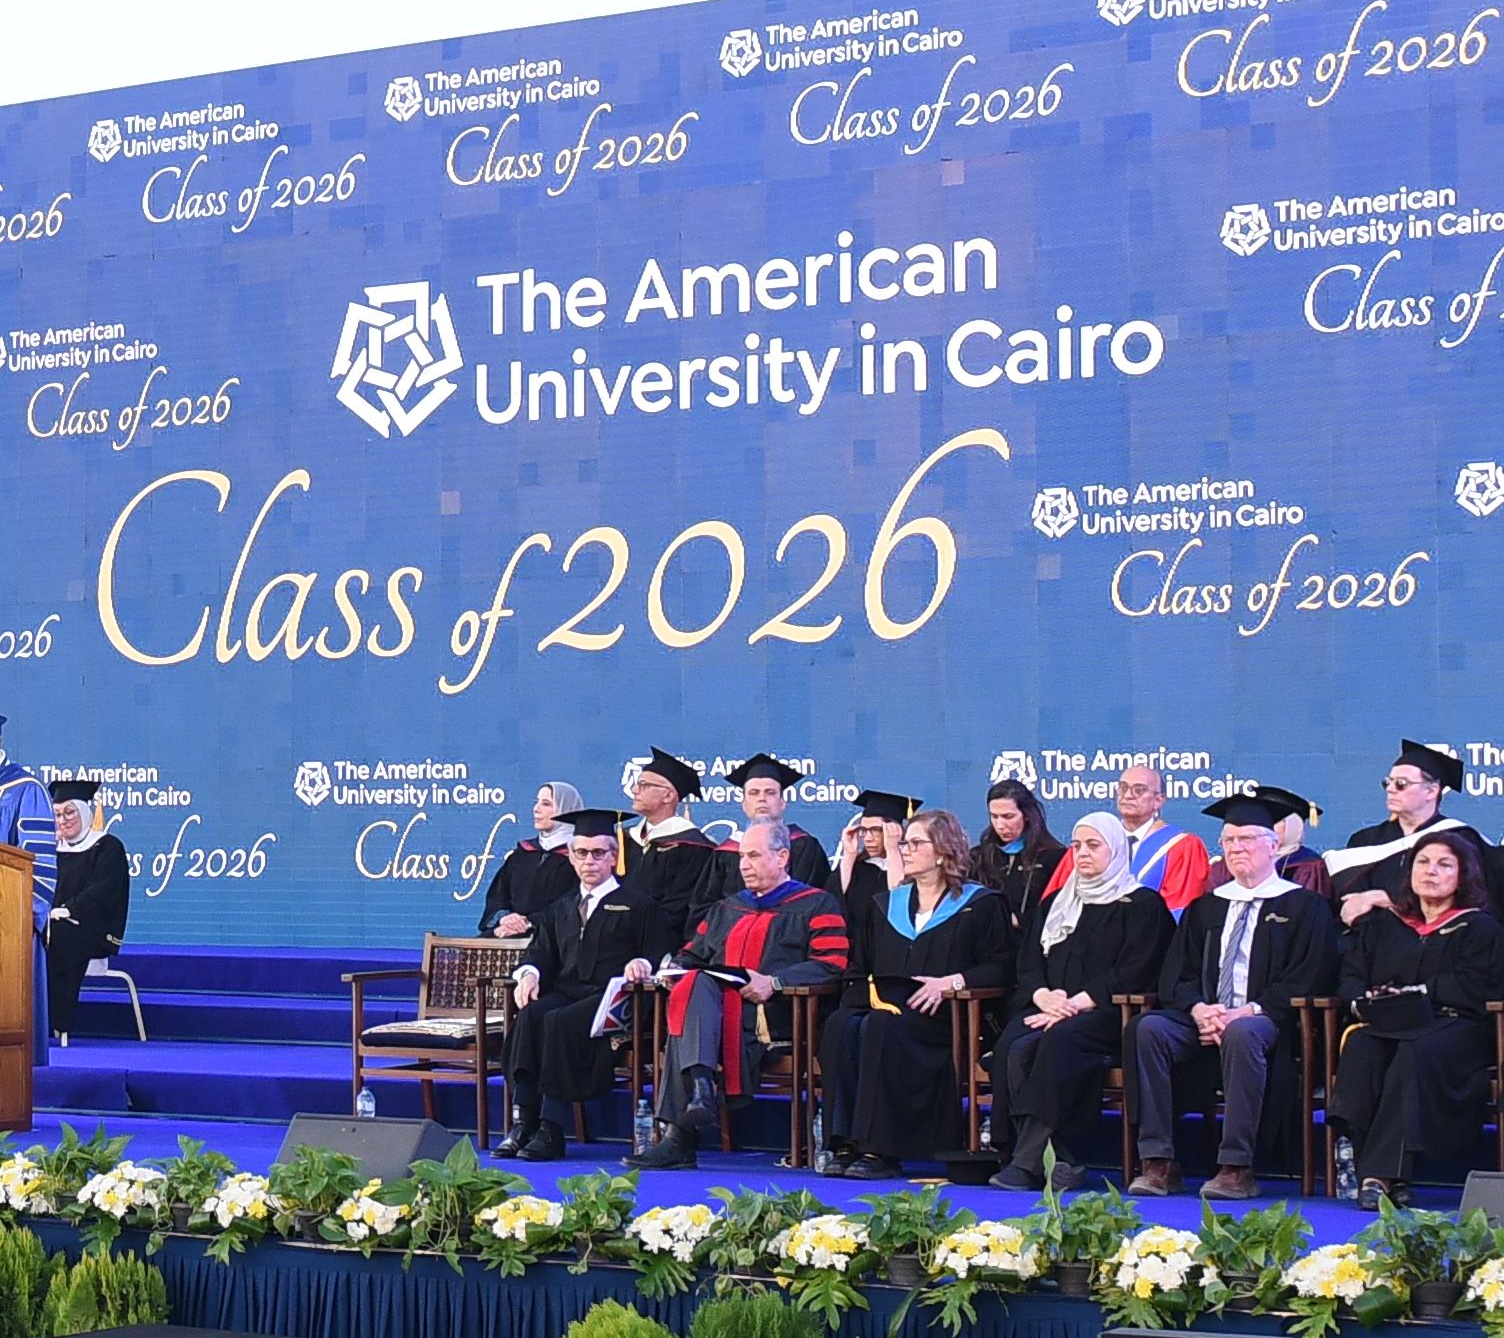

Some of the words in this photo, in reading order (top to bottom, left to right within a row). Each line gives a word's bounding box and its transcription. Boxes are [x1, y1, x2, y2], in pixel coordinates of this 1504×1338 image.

[765, 23, 807, 46] The
[810, 8, 919, 40] American
[765, 38, 875, 72] University
[878, 34, 900, 57] in
[901, 26, 964, 53] Cairo
[1177, 13, 1302, 97] Class
[1307, 0, 1388, 108] of
[1363, 7, 1501, 77] 2026
[424, 70, 463, 92] The
[464, 58, 562, 87] American
[424, 86, 522, 117] University
[525, 82, 544, 104] in
[546, 76, 600, 101] Cairo
[790, 66, 900, 145] Class
[904, 54, 977, 155] of
[954, 62, 1075, 127] 2026
[123, 114, 157, 135] The
[159, 102, 245, 130] American
[123, 122, 211, 159] University
[212, 125, 229, 146] in
[231, 119, 279, 143] Cairo
[446, 113, 544, 186] Class
[546, 102, 612, 197] of
[591, 111, 700, 171] 2026
[142, 154, 230, 223] Class
[231, 144, 289, 234] of
[270, 153, 366, 209] 2026
[1273, 198, 1323, 223] The
[1326, 185, 1456, 218] American
[1273, 218, 1404, 252] University
[1408, 214, 1433, 239] in
[476, 268, 607, 335] The
[624, 230, 997, 323] American
[1304, 249, 1435, 333] Class
[9, 329, 41, 349] The
[42, 321, 125, 346] American
[8, 346, 92, 373] University
[94, 343, 110, 364] in
[111, 339, 158, 362] Cairo
[476, 332, 841, 425] University
[860, 322, 927, 396] in
[946, 304, 1164, 388] Cairo
[27, 371, 110, 438] Class
[112, 365, 168, 451] of
[150, 377, 240, 429] 2026
[1082, 484, 1129, 507] The
[1132, 476, 1254, 504] American
[1082, 506, 1205, 535] University
[1208, 504, 1232, 529] in
[1235, 500, 1304, 527] Cairo
[97, 468, 423, 665] Class
[438, 532, 552, 695] of
[537, 428, 1010, 652] 2026
[1111, 549, 1233, 617] Class
[1238, 533, 1319, 637] of
[1295, 551, 1430, 610] 2026
[333, 760, 370, 781] The
[372, 758, 467, 780] American
[333, 783, 429, 809] University
[431, 782, 450, 805] in
[452, 782, 505, 805] Cairo
[355, 811, 450, 879] Class
[453, 813, 516, 901] of
